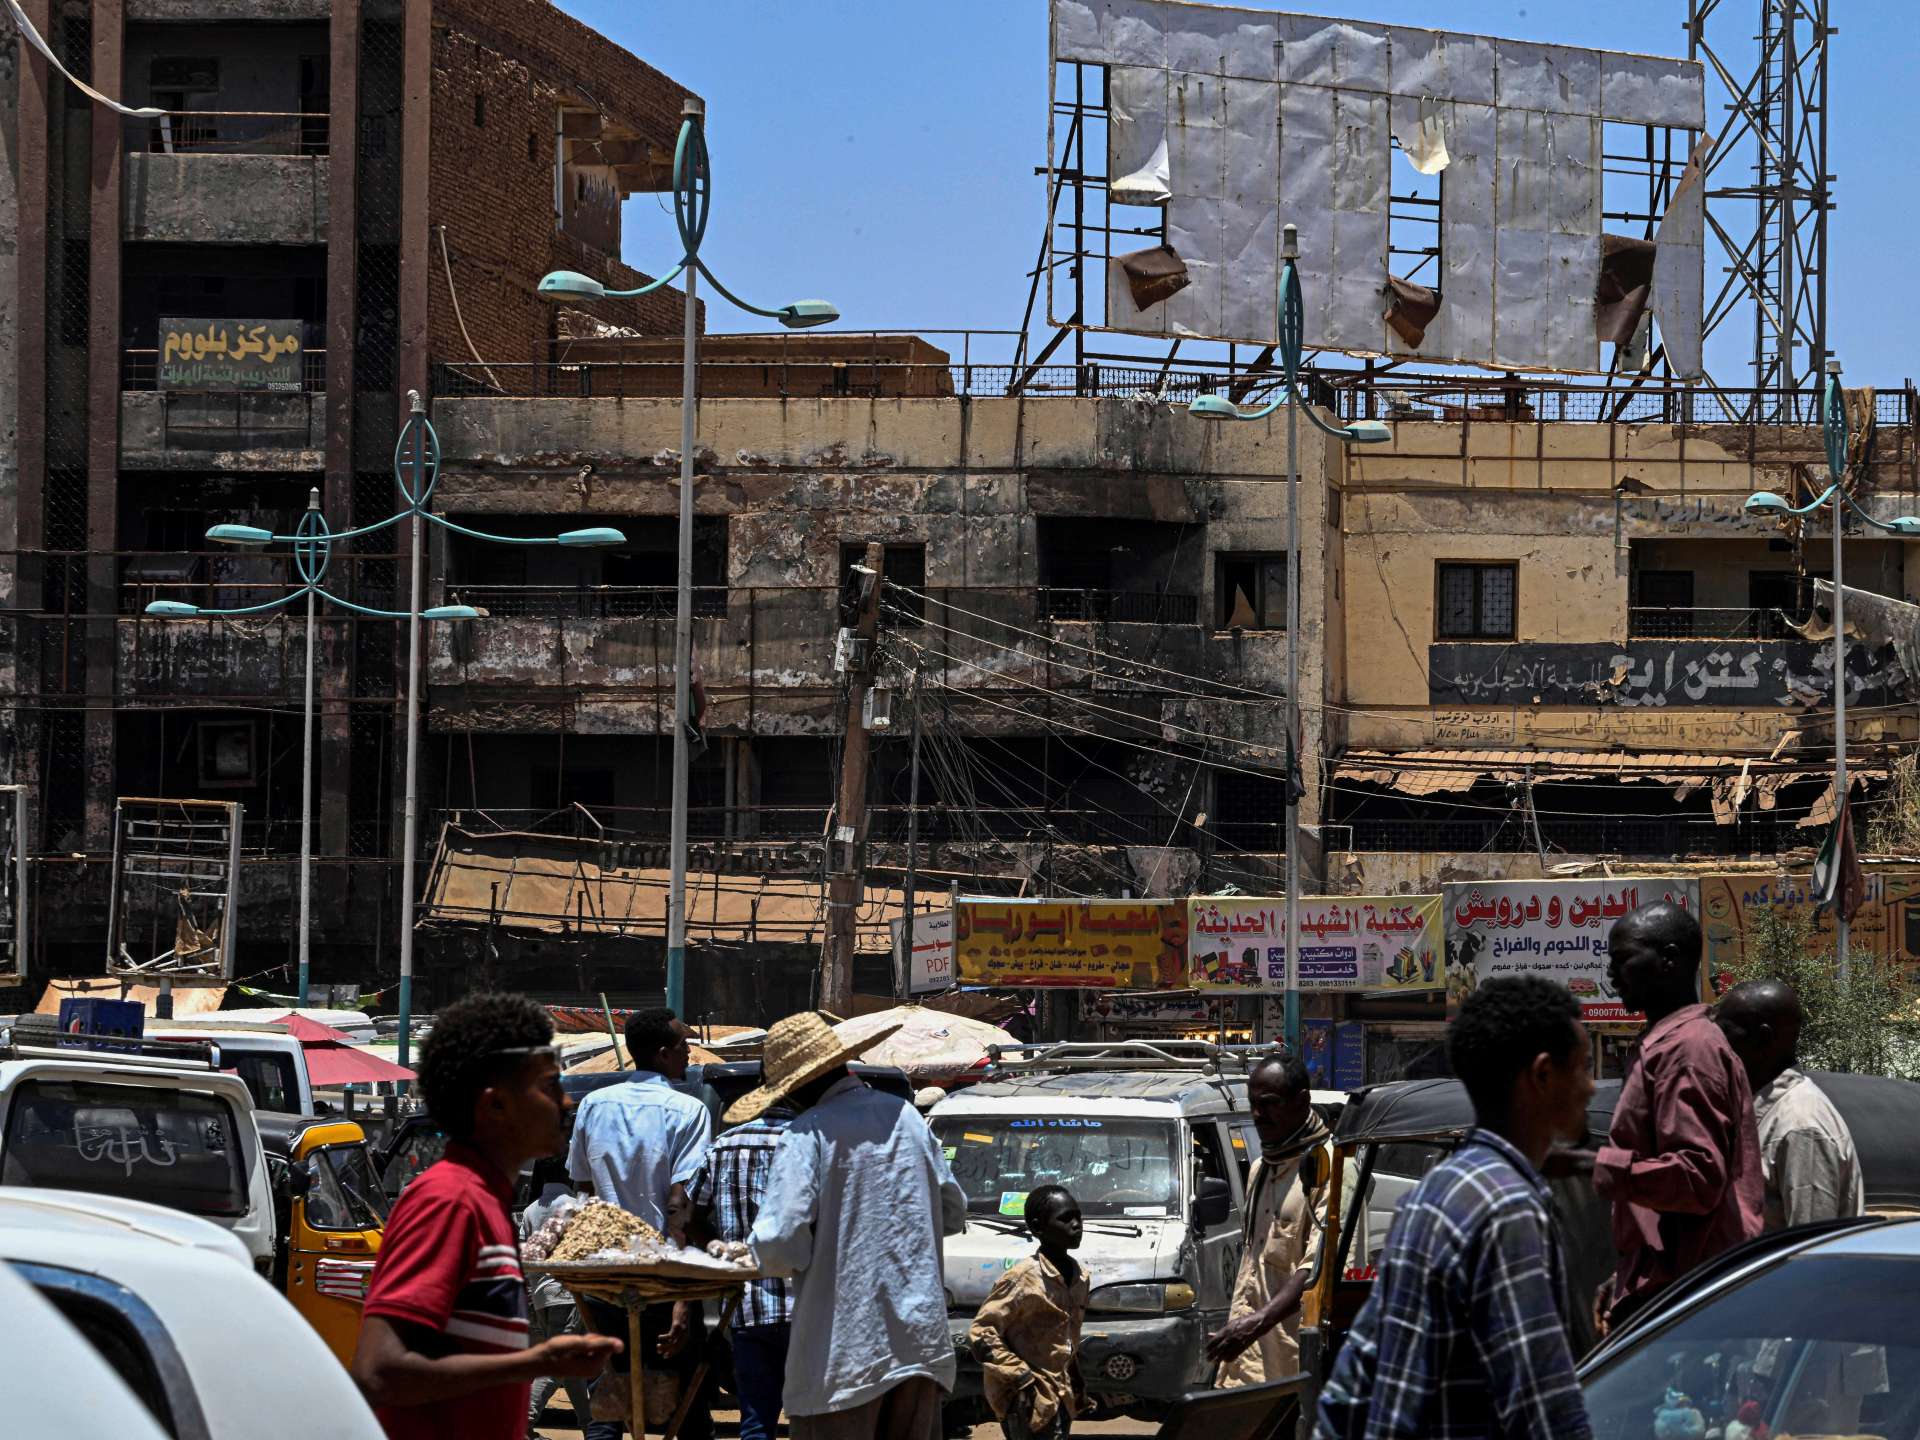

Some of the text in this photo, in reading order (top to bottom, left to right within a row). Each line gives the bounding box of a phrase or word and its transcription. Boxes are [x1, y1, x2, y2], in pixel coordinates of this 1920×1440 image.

[227, 324, 299, 363] مركز
[1193, 904, 1275, 944] الحديثة
[1362, 904, 1425, 940] مكتبة
[1455, 888, 1541, 929] درويش
[1493, 936, 1541, 957] والفراخ
[1544, 936, 1590, 956] اللحوم
[926, 957, 950, 973] PDF
